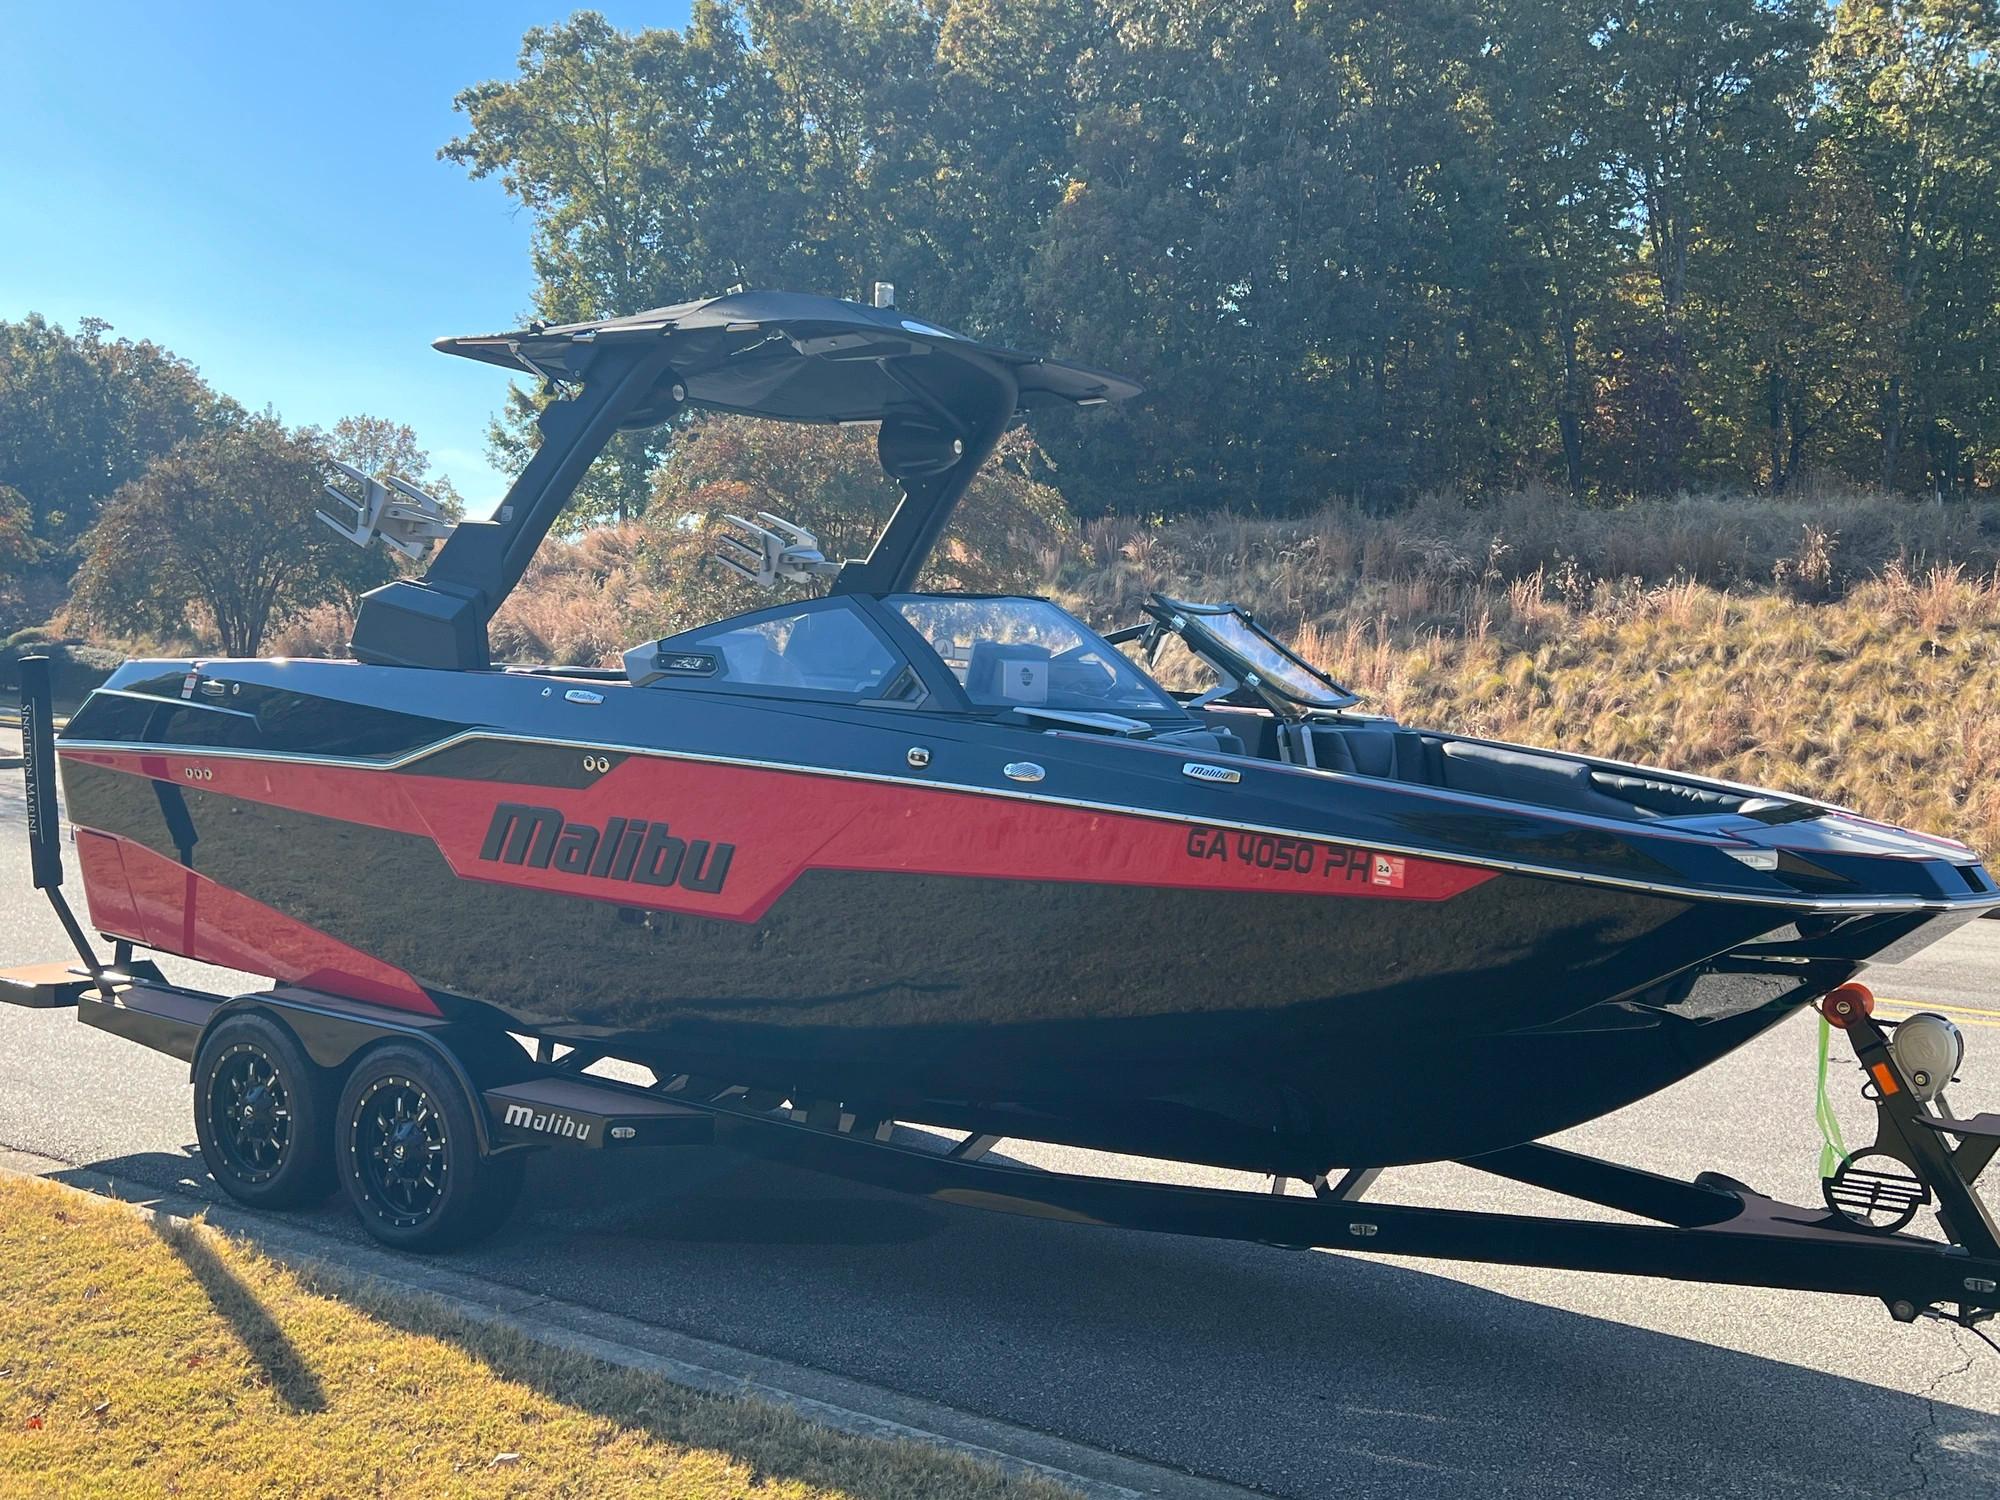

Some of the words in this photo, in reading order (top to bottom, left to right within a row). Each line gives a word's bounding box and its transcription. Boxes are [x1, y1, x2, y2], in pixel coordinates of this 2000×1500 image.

[21, 704, 33, 777] SINGLETON
[1190, 766, 1230, 780] Malibu
[26, 782, 38, 836] MARINE
[479, 802, 736, 894] Malibu
[1187, 828, 1228, 862] GA
[1237, 834, 1315, 874] 4050
[1323, 847, 1372, 883] PH
[1378, 864, 1390, 873] 24
[504, 1104, 591, 1141] Malibu
